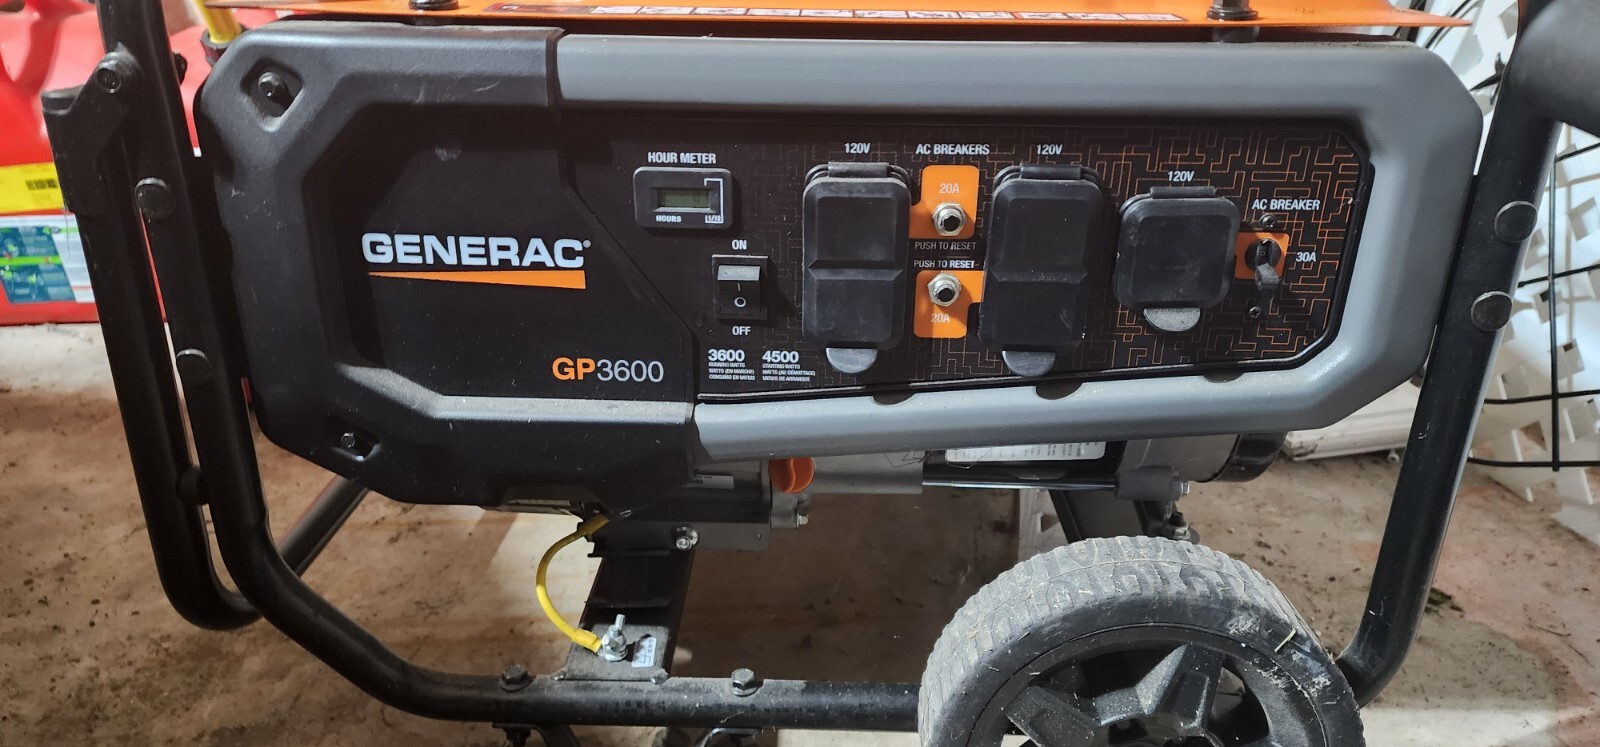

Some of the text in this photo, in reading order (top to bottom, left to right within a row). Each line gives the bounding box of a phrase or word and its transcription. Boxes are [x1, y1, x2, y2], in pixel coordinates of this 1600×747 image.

[844, 143, 871, 154] 120V
[915, 144, 990, 155] AC BREAKERS
[1036, 144, 1063, 155] 120V
[647, 151, 717, 164] HOUR METER
[1167, 170, 1195, 182] 120V
[939, 183, 960, 194] 20A
[1252, 199, 1321, 210] AC BREAKER
[655, 214, 682, 223] HOURS
[361, 232, 584, 268] GENERAC
[731, 239, 747, 250] ON
[914, 241, 977, 251] PUSH TO RESET
[1295, 251, 1317, 263] 30A
[913, 259, 975, 269] PUSH TO RESET
[930, 313, 950, 323] 20A
[731, 325, 751, 336] OFF
[707, 348, 746, 362] 3600
[761, 350, 800, 363] 4500
[551, 357, 665, 383] GP3600
